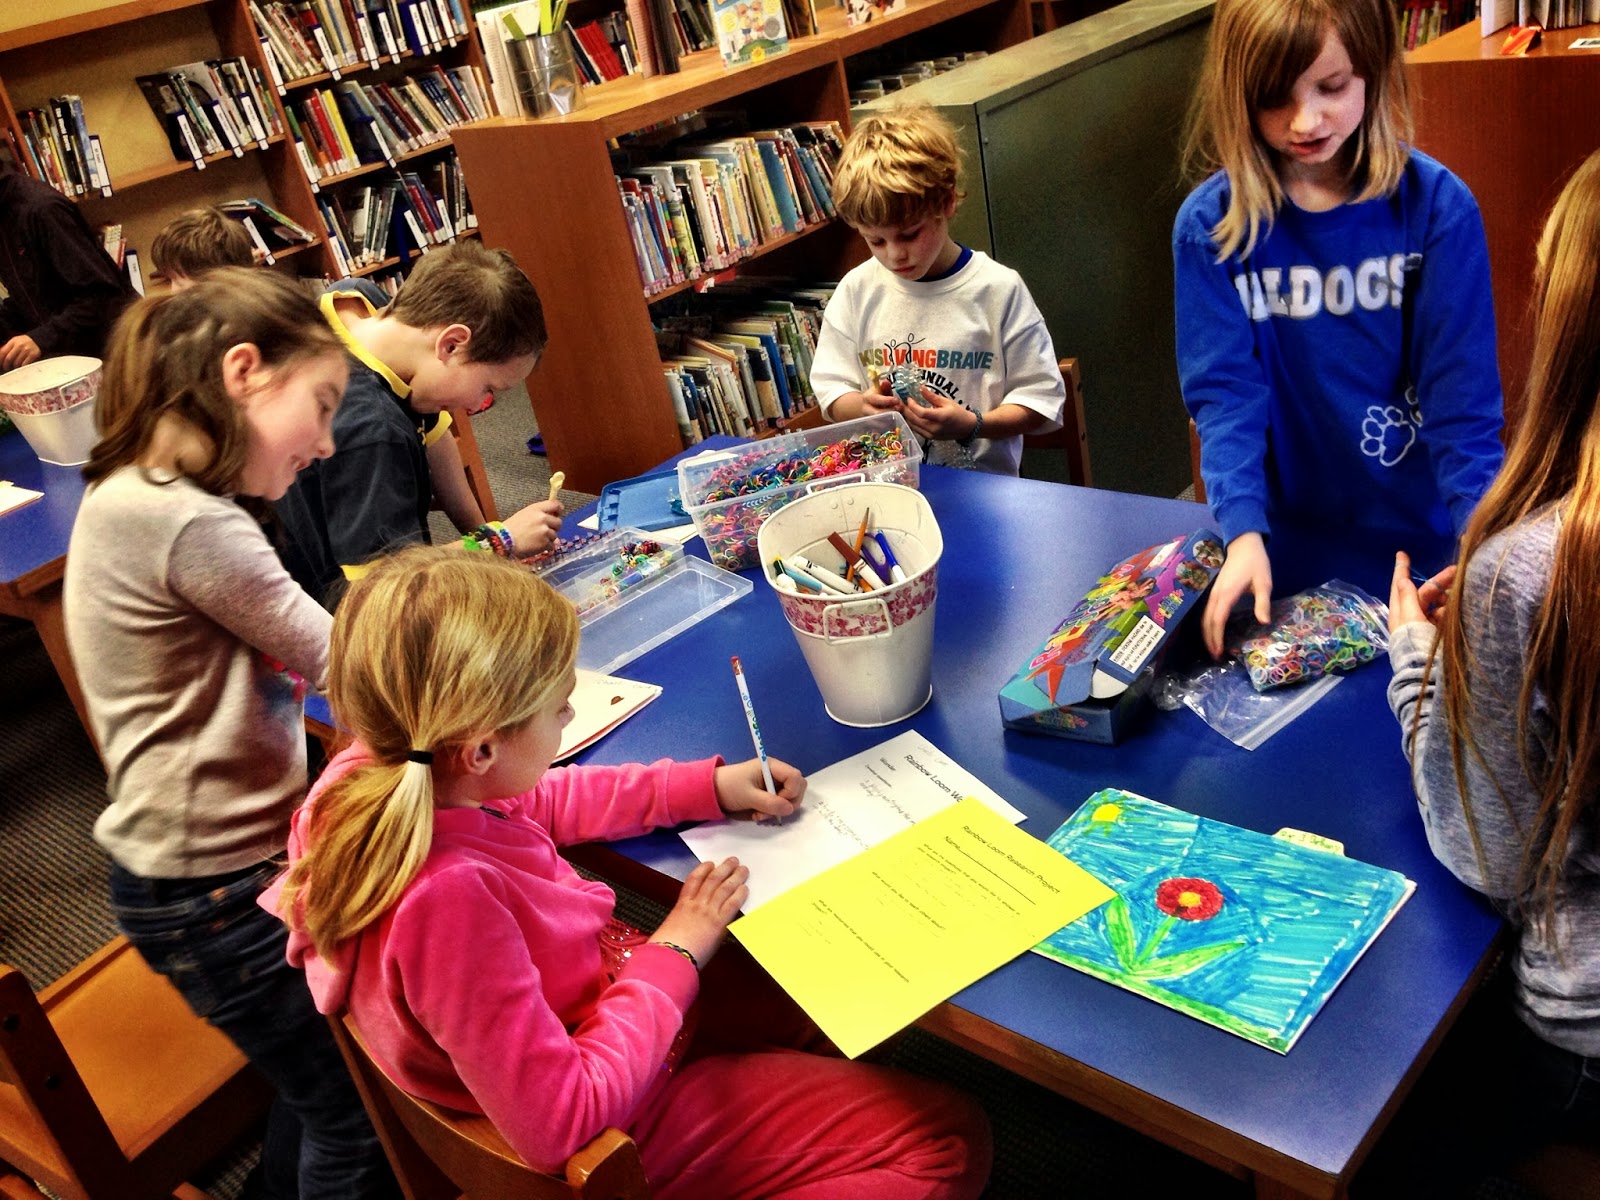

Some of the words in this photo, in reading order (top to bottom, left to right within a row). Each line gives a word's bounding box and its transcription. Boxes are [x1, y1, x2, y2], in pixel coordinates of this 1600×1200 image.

[903, 754, 933, 777] Rainbow
[929, 775, 953, 793] Loom
[960, 825, 990, 844] Rainbow
[985, 842, 1007, 856] Loom
[1003, 854, 1037, 876] Research
[1032, 874, 1062, 894] Project
